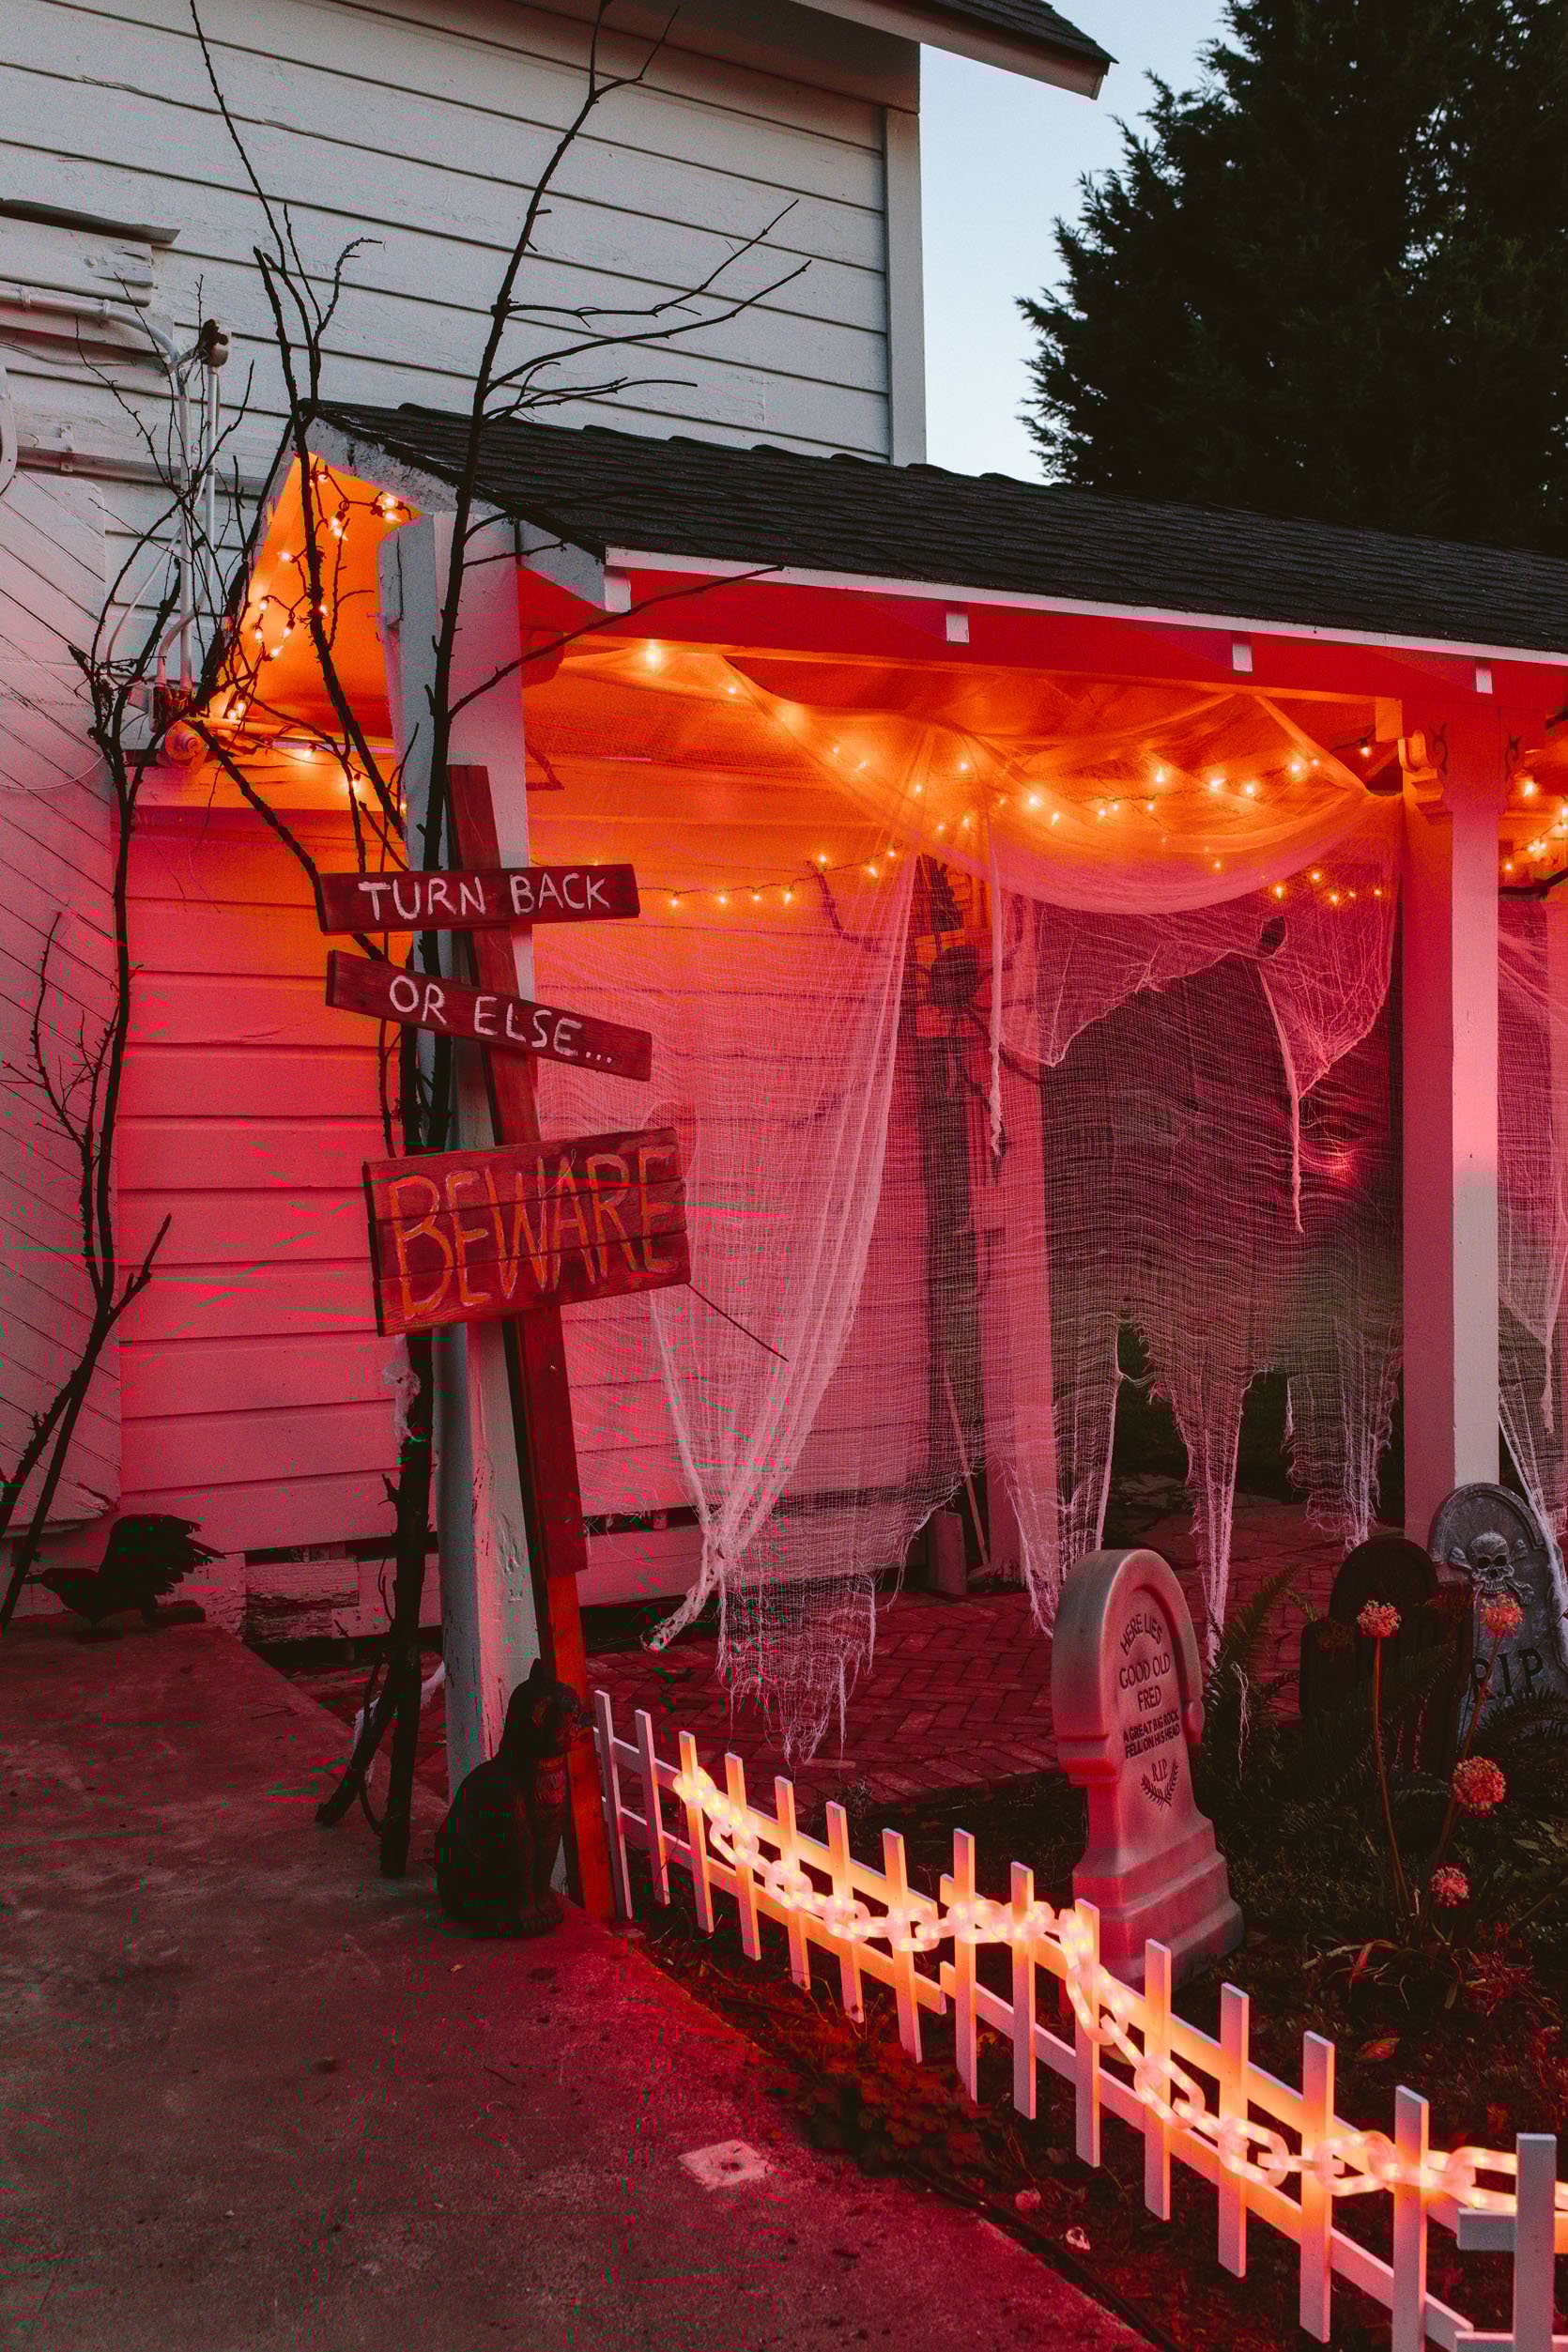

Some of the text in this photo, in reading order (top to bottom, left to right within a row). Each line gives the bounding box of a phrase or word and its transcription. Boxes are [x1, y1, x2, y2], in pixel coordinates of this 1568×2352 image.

[359, 871, 610, 920] TURN BACK
[389, 975, 448, 1025] OR
[388, 1145, 678, 1320] BEWARE
[1120, 1612, 1162, 1655] HERE LIES
[1119, 1653, 1171, 1690] GOOD OLD
[1137, 1685, 1161, 1712] FRED
[1123, 1708, 1180, 1744] A GREAT BIG ROCK
[1125, 1722, 1180, 1760] FELL ON HIS HEAD
